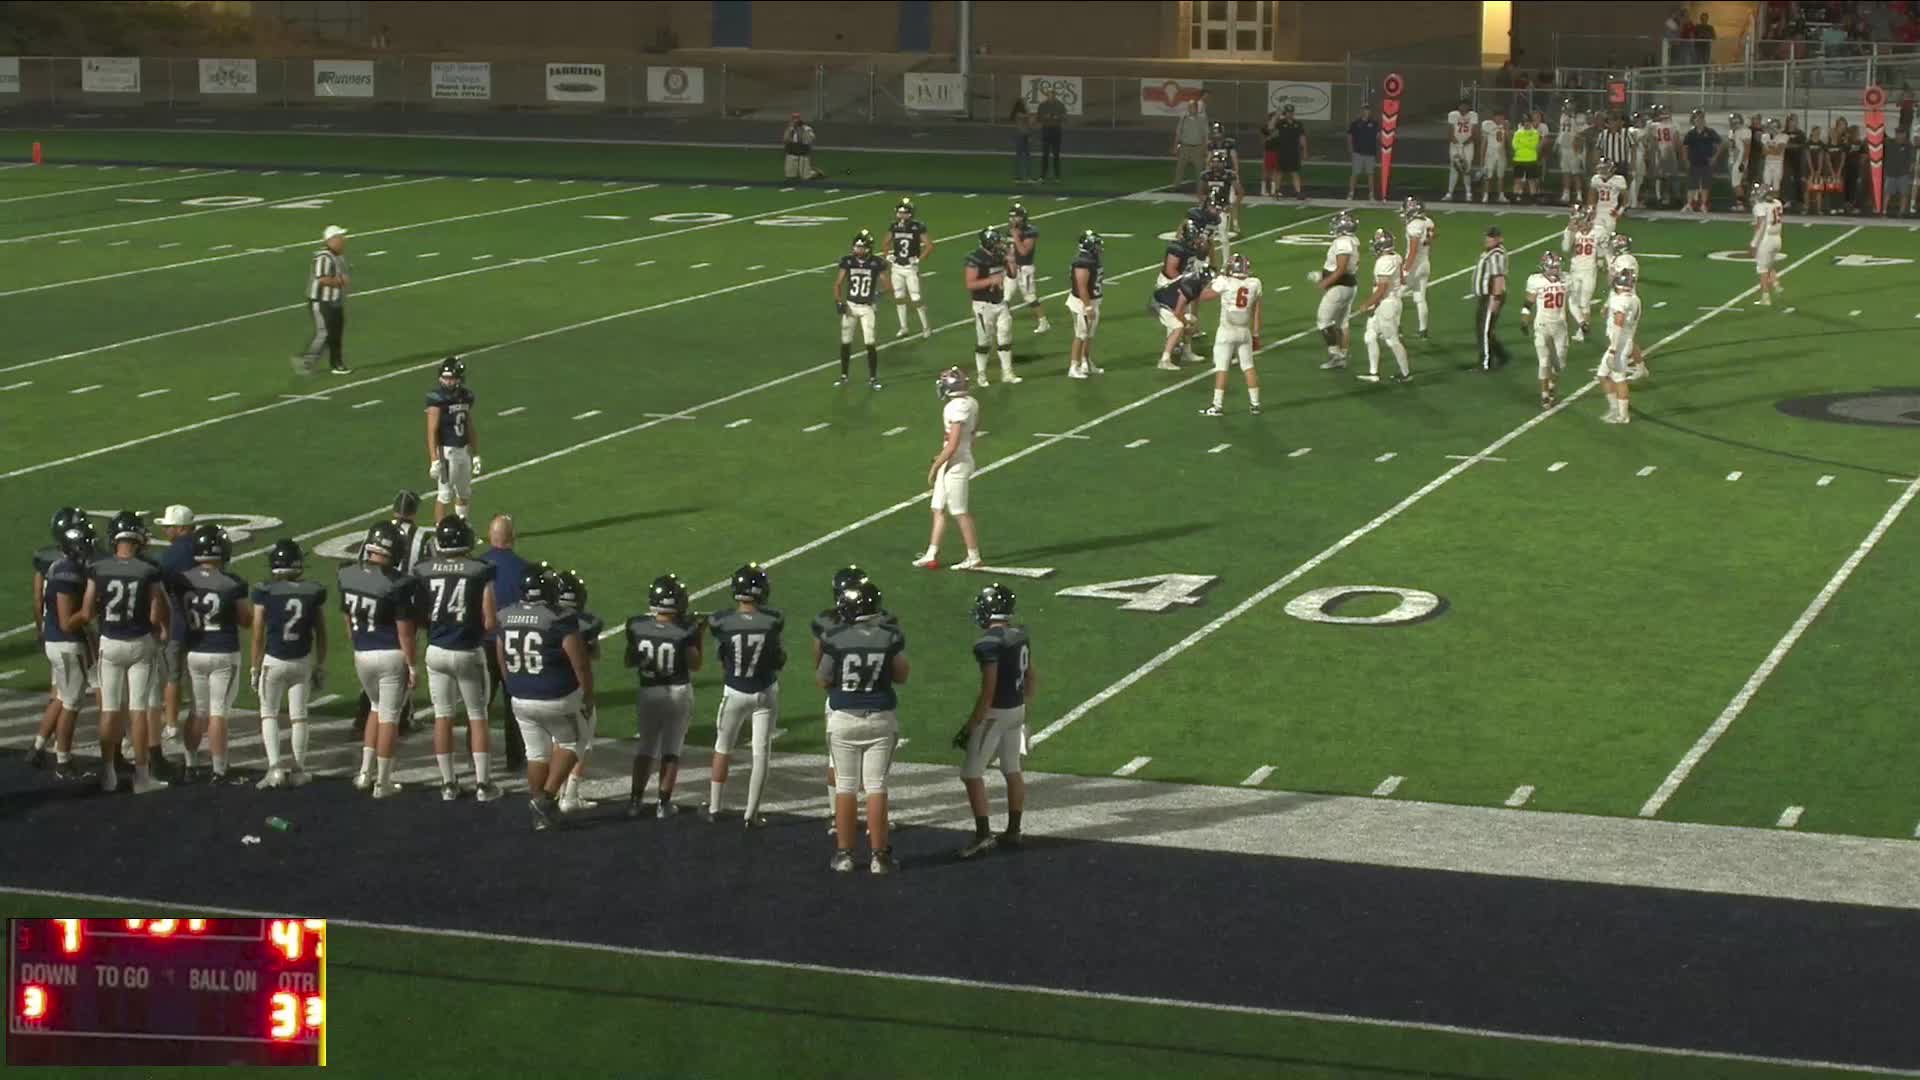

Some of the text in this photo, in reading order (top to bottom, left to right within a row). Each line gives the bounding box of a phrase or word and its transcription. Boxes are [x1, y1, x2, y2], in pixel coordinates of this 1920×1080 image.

[899, 239, 910, 258] 3
[849, 275, 873, 297] 30
[1236, 287, 1250, 309] 6
[1543, 292, 1565, 309] 20
[105, 579, 139, 622] 21
[282, 598, 304, 641] 2
[344, 592, 378, 633] 77
[429, 577, 467, 622] 74
[503, 630, 544, 675] 56
[730, 633, 766, 678] 17
[841, 652, 886, 693] 67
